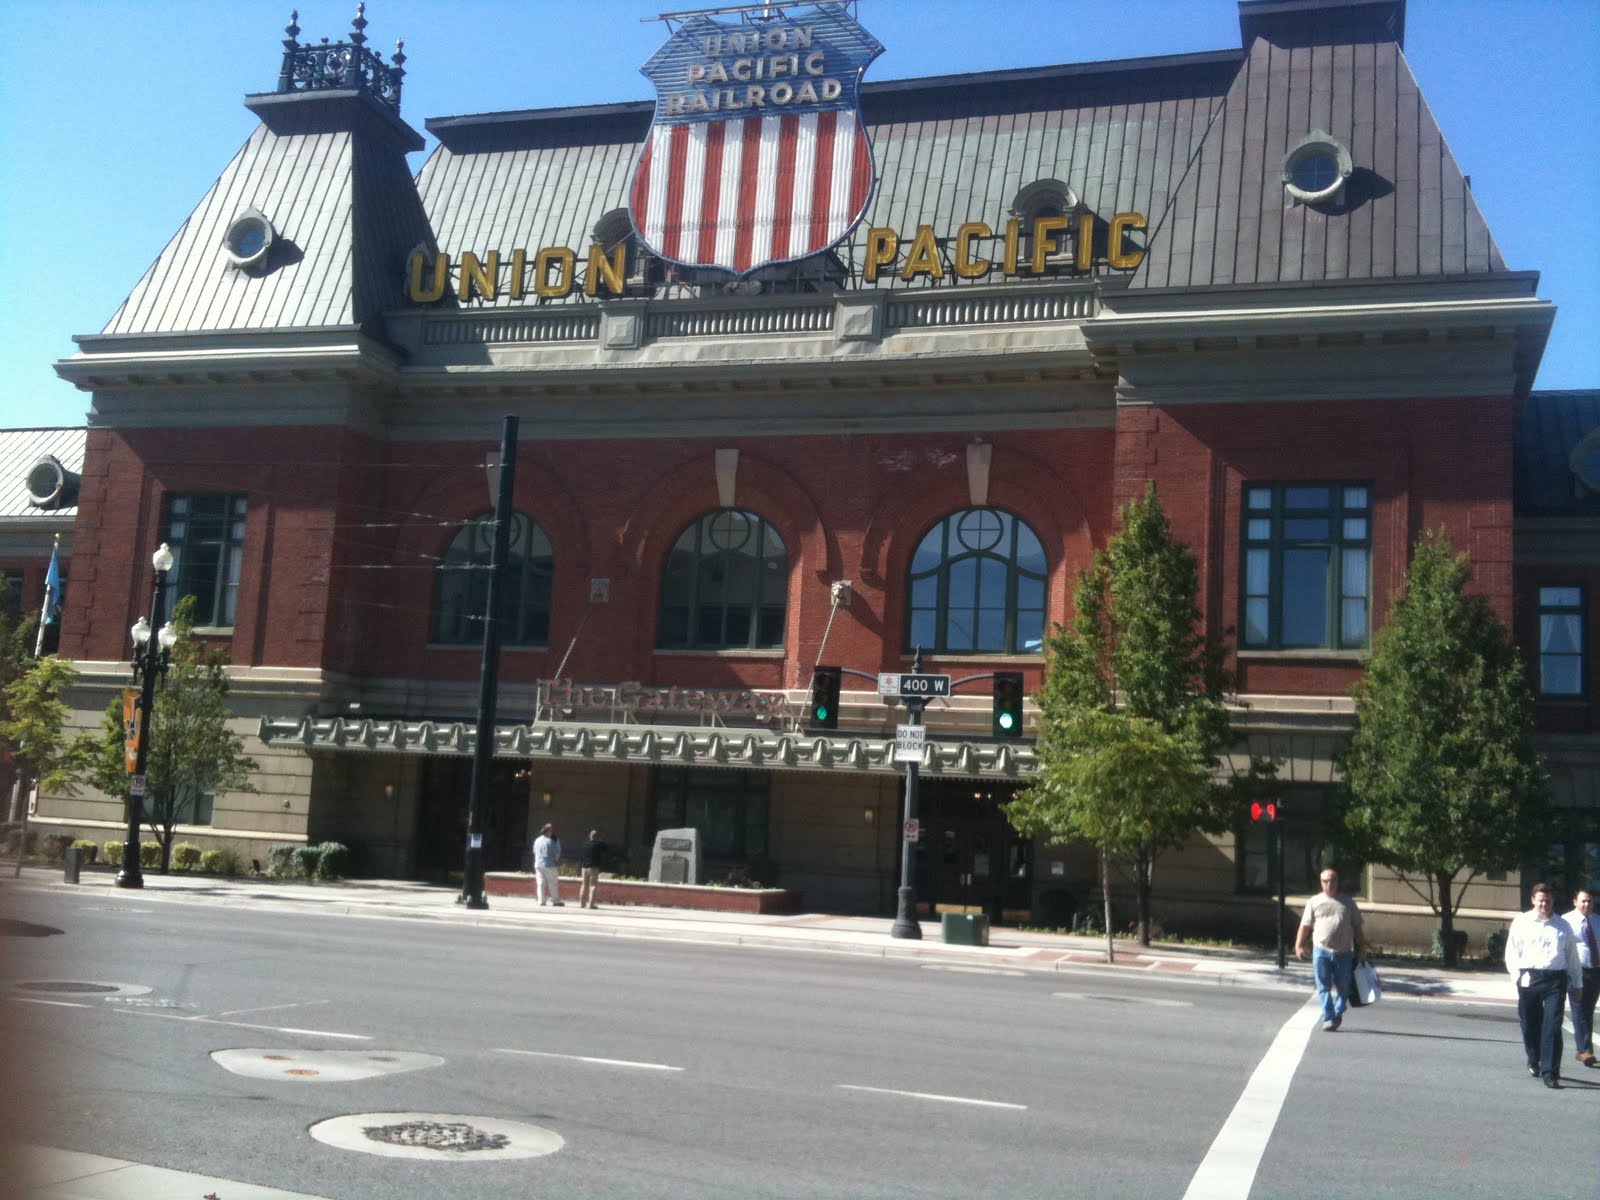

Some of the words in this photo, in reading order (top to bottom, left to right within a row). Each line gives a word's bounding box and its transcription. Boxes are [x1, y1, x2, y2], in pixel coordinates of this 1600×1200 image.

[703, 26, 814, 56] UNION
[687, 50, 825, 84] PACIFIC
[665, 78, 842, 115] RAILROAD
[409, 241, 627, 303] UNION
[864, 211, 1148, 283] PACIFIC
[616, 680, 784, 723] Gateway
[903, 679, 928, 692] 400
[934, 680, 944, 692] W
[896, 740, 923, 750] BLOCK
[897, 730, 908, 739] DO
[910, 730, 924, 739] NOT
